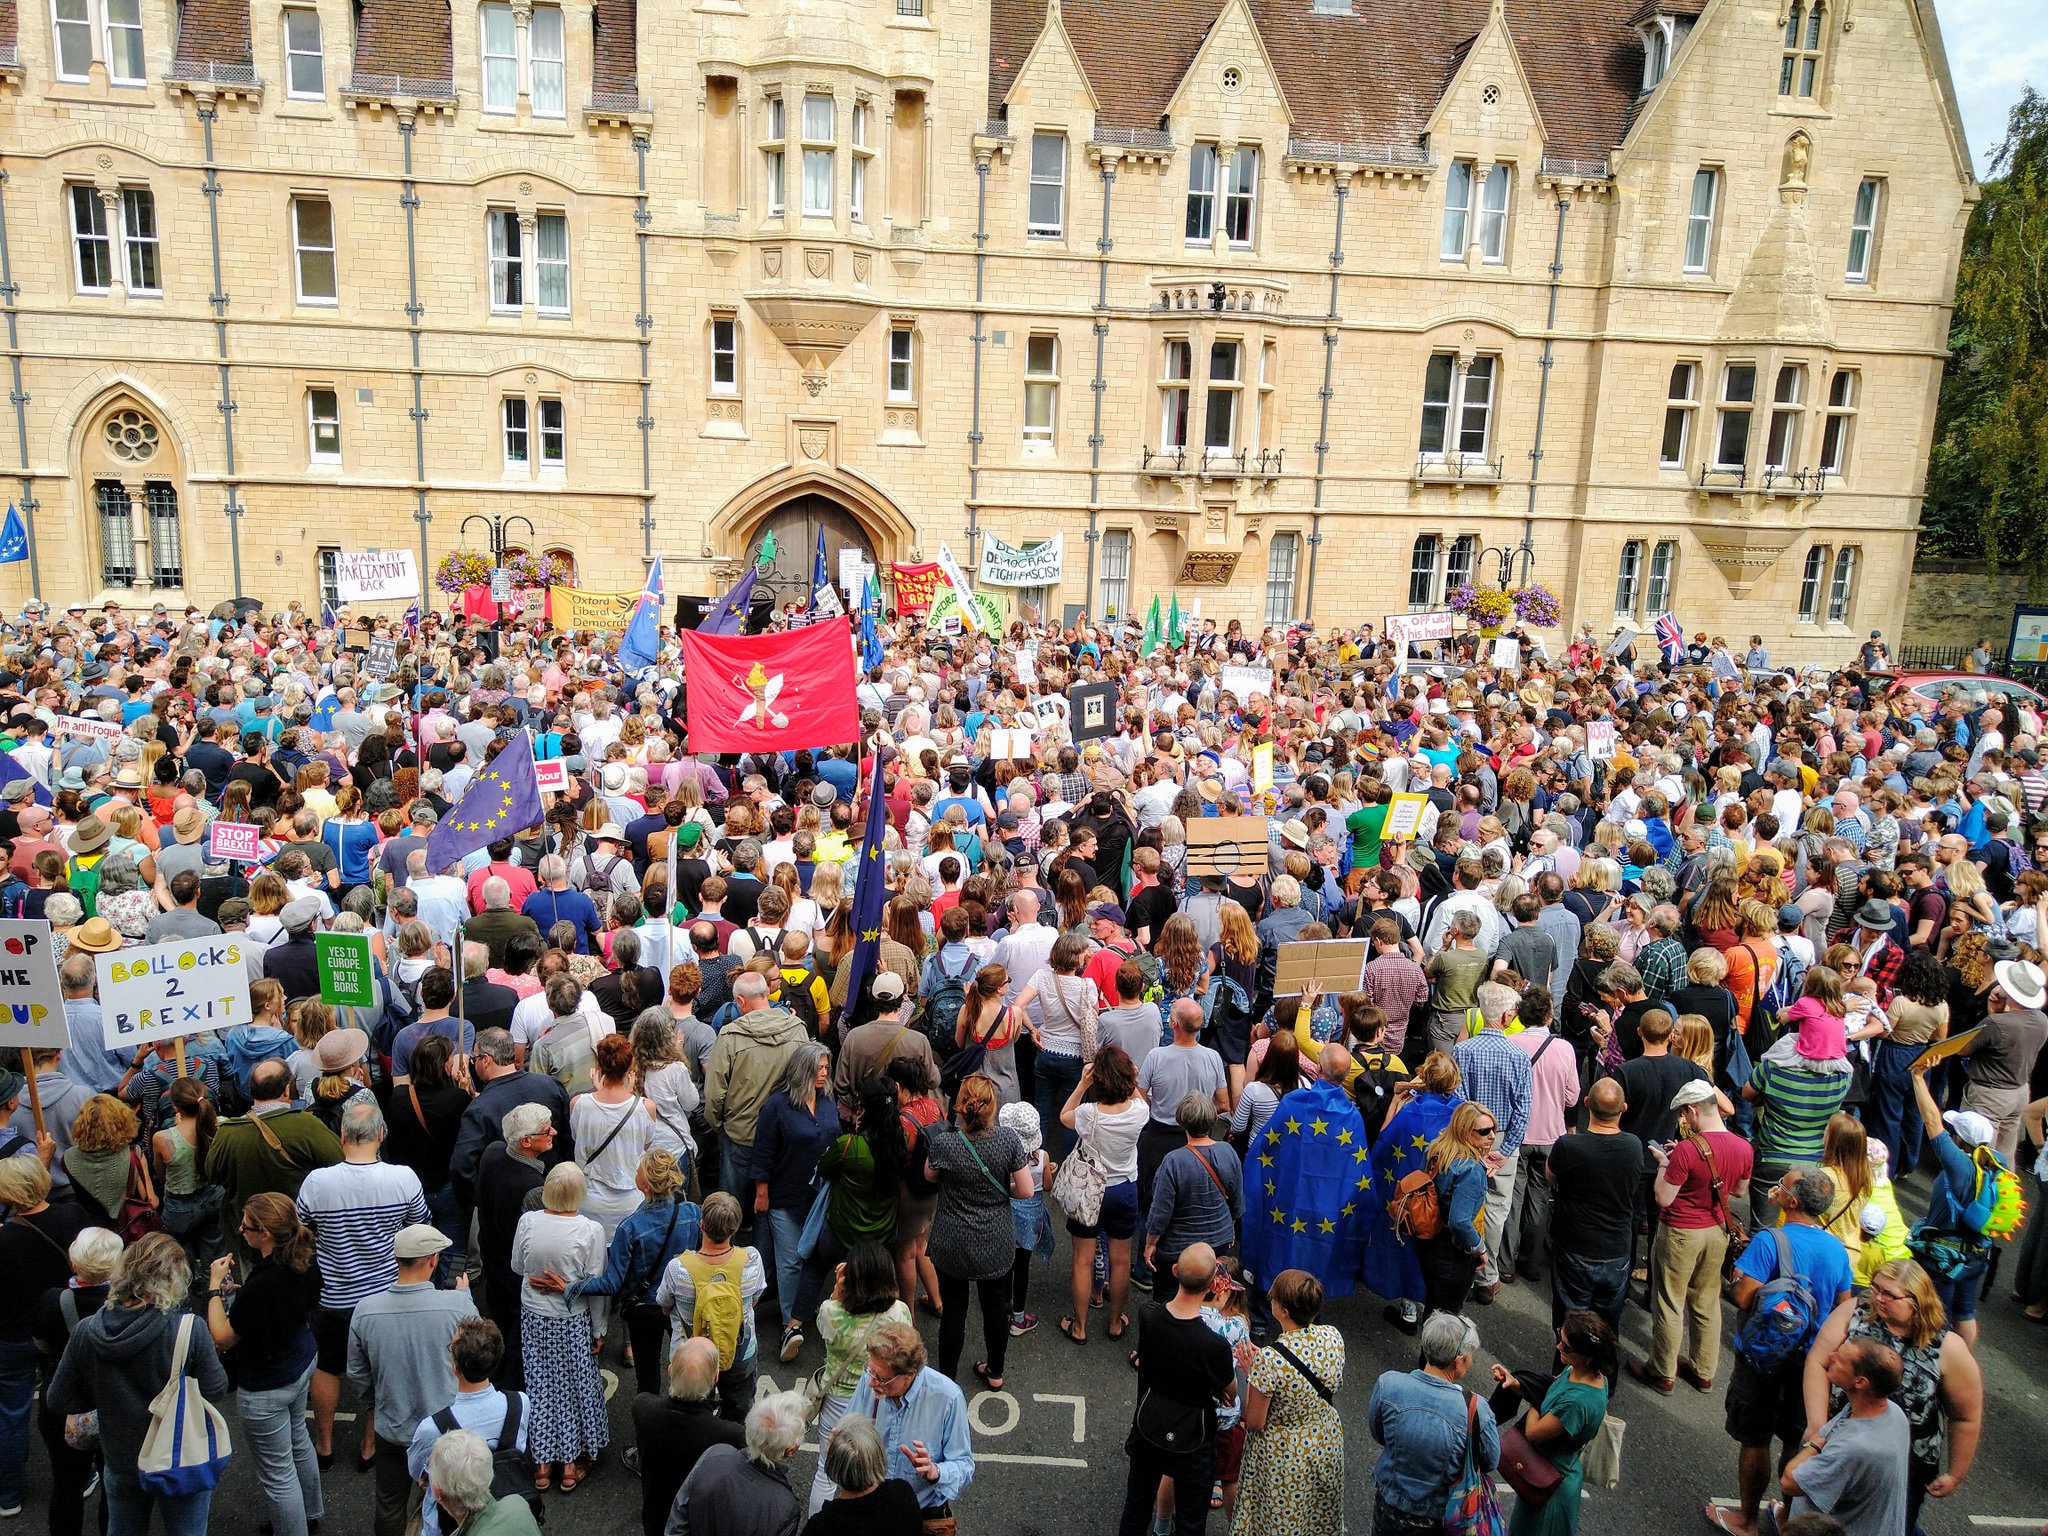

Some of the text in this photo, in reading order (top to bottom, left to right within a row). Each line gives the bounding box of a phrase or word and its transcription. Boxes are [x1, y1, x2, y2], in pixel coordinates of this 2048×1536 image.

[350, 553, 380, 563] WANT
[386, 551, 400, 561] MY
[986, 551, 1058, 568] DEMOCRACY
[339, 562, 406, 581] PARLIAMENT
[989, 567, 1060, 581] FIGHT FASCISM
[360, 579, 385, 591] BACK
[898, 579, 947, 593] REMAN
[572, 595, 610, 605] Oxford
[902, 592, 933, 606] LABO
[573, 607, 610, 616] Liberal
[930, 593, 957, 626] OXFORD
[985, 601, 1002, 631] PARTY
[1432, 613, 1451, 624] with
[1408, 628, 1422, 640] his
[57, 716, 121, 739] I'm anti-rogue
[1587, 723, 1613, 740] ROGU
[536, 772, 561, 781] bour
[217, 827, 254, 841] STOP
[216, 838, 254, 851] BREXIT
[0, 934, 38, 955] OP
[328, 946, 358, 958] YES TO
[327, 957, 363, 970] EUROPE.
[0, 969, 31, 985] HE
[333, 971, 358, 983] NO TO
[165, 977, 184, 998] 2
[334, 981, 362, 993] BORIS.
[0, 1003, 48, 1026] OUP
[116, 996, 235, 1034] BREXIT
